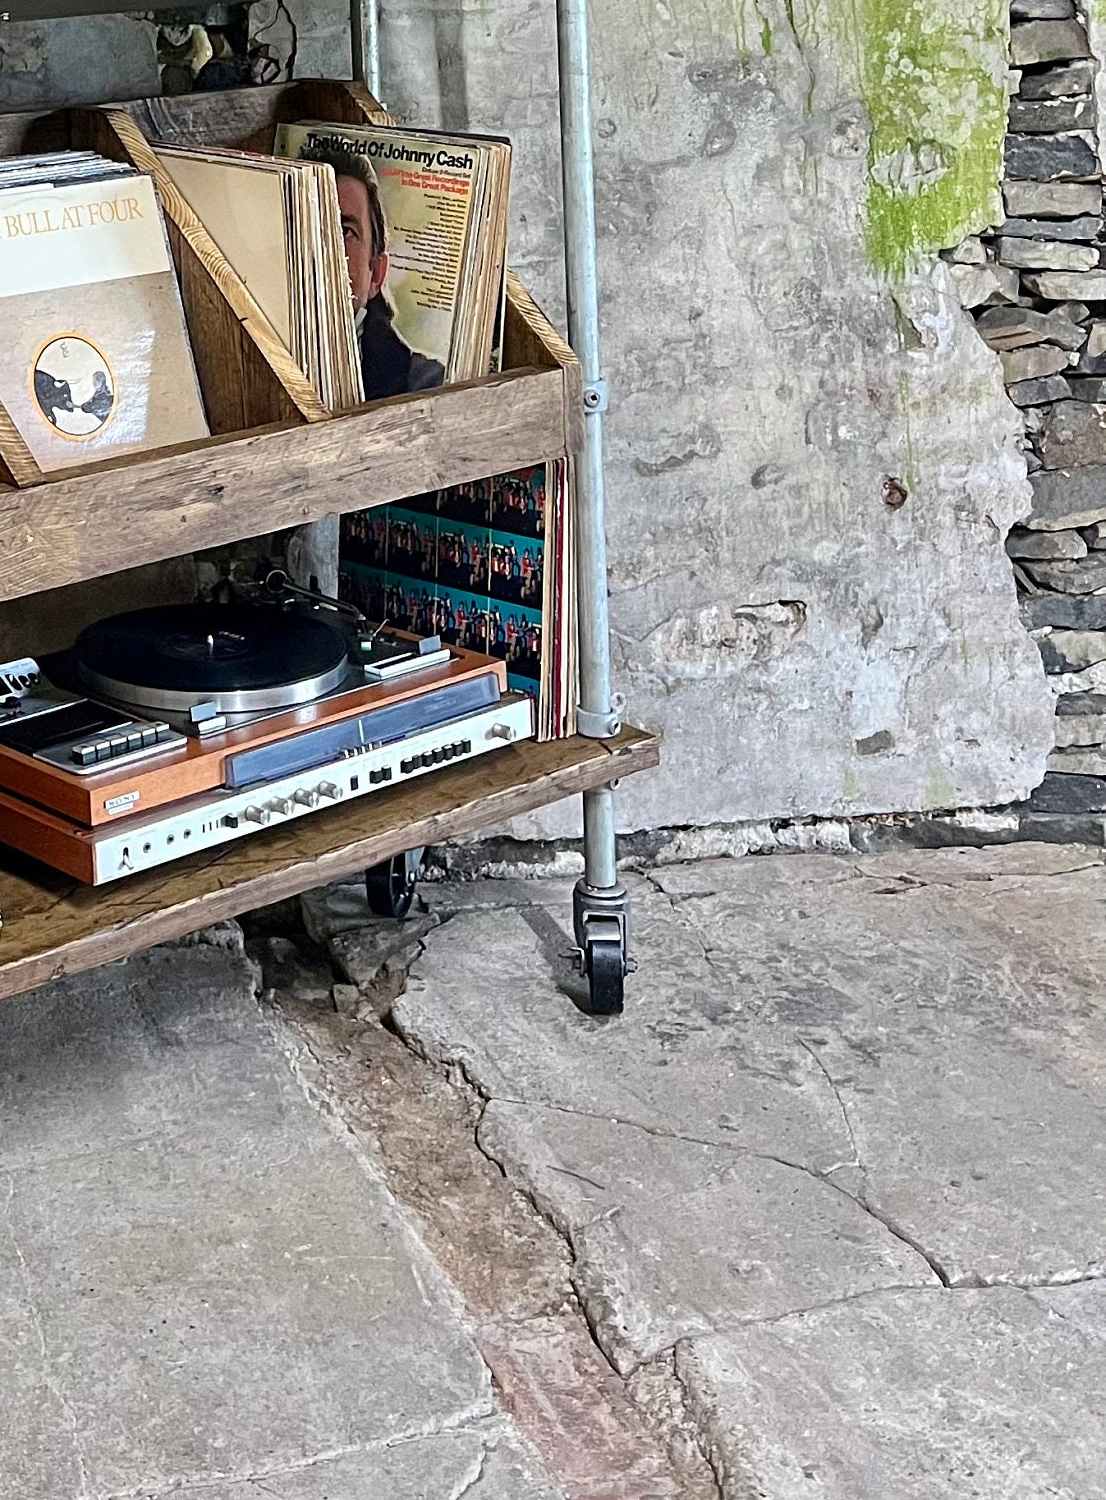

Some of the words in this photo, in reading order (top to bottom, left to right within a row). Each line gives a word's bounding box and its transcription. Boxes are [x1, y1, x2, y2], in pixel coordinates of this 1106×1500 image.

[306, 133, 329, 150] The
[328, 133, 367, 156] World
[367, 140, 385, 158] Of
[383, 143, 436, 168] Johnny
[436, 150, 473, 170] Cash
[4, 209, 59, 238] BULL
[61, 204, 85, 230] AT
[88, 197, 143, 226] FOUR
